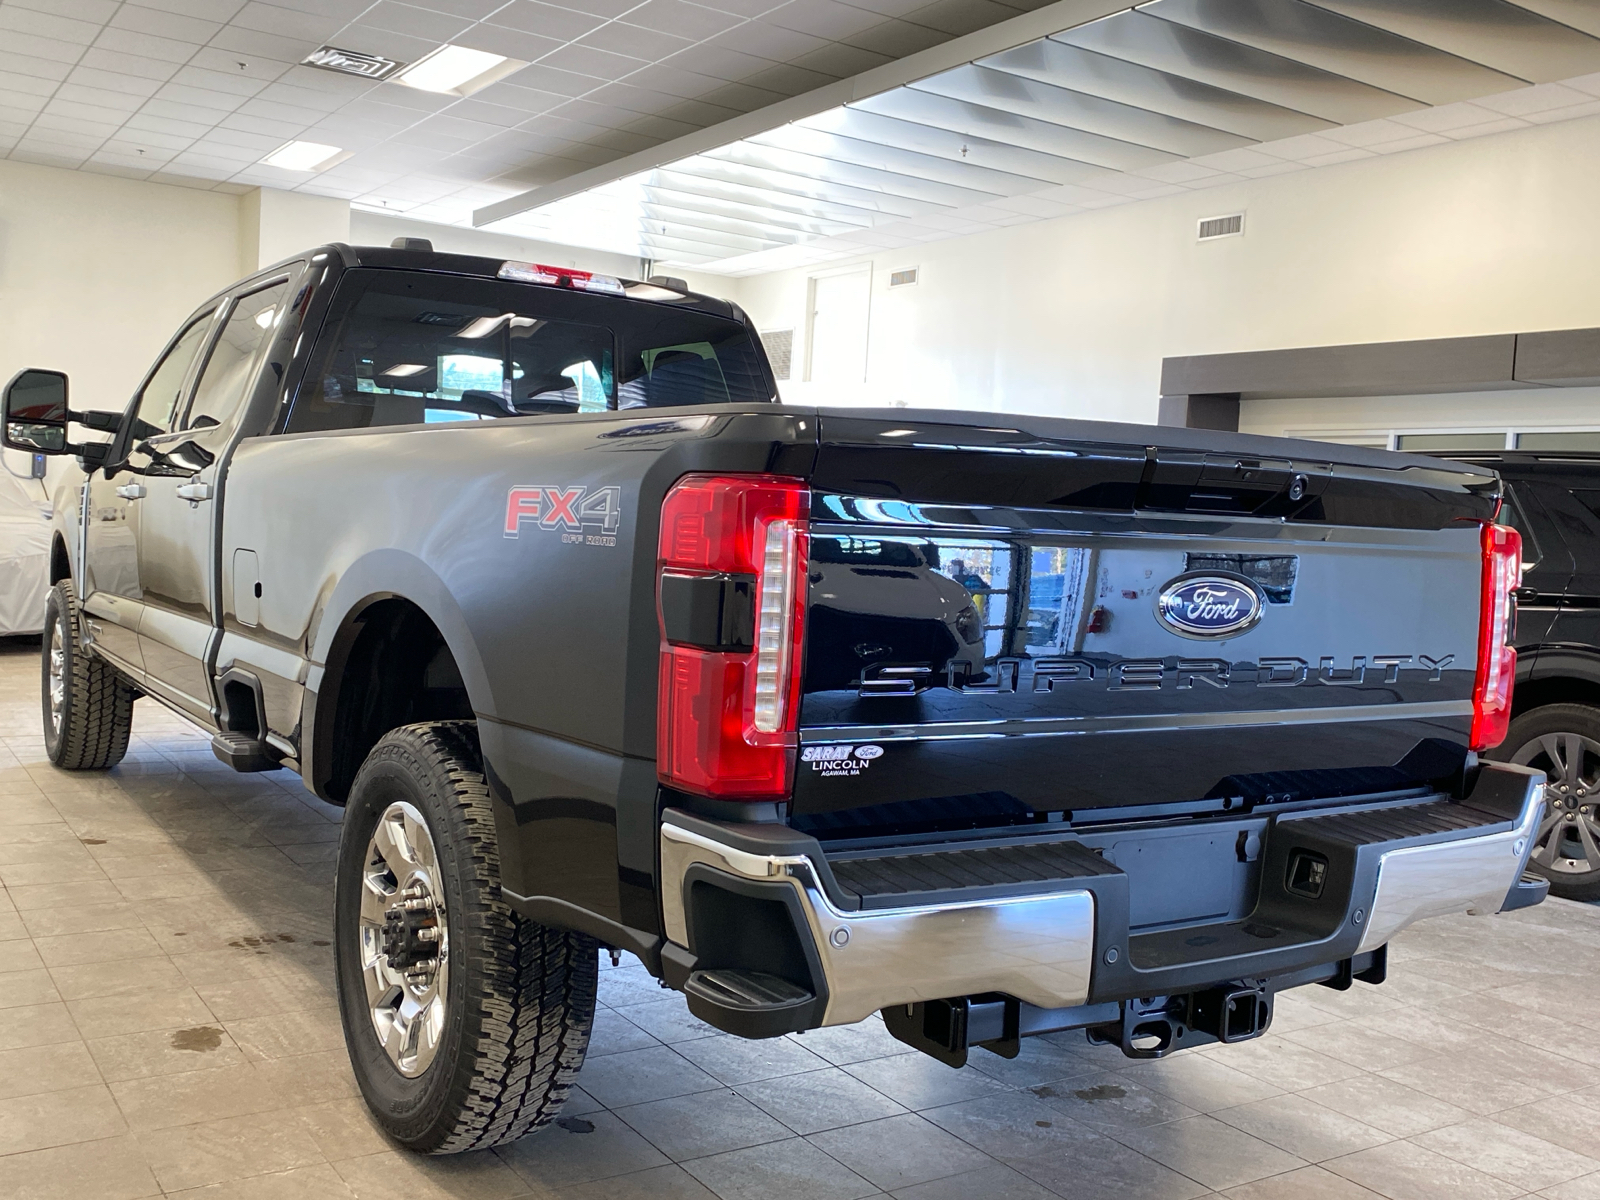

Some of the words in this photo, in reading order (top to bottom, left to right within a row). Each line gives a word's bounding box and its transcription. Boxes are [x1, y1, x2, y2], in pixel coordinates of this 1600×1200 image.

[503, 485, 621, 539] FX4
[561, 533, 584, 545] OFF
[586, 535, 617, 547] ROAD
[1186, 586, 1240, 620] Ford
[858, 656, 1232, 697] SUPER
[1256, 654, 1456, 688] DUTY
[801, 745, 853, 761] SARAT
[813, 760, 869, 770] LINCOLN
